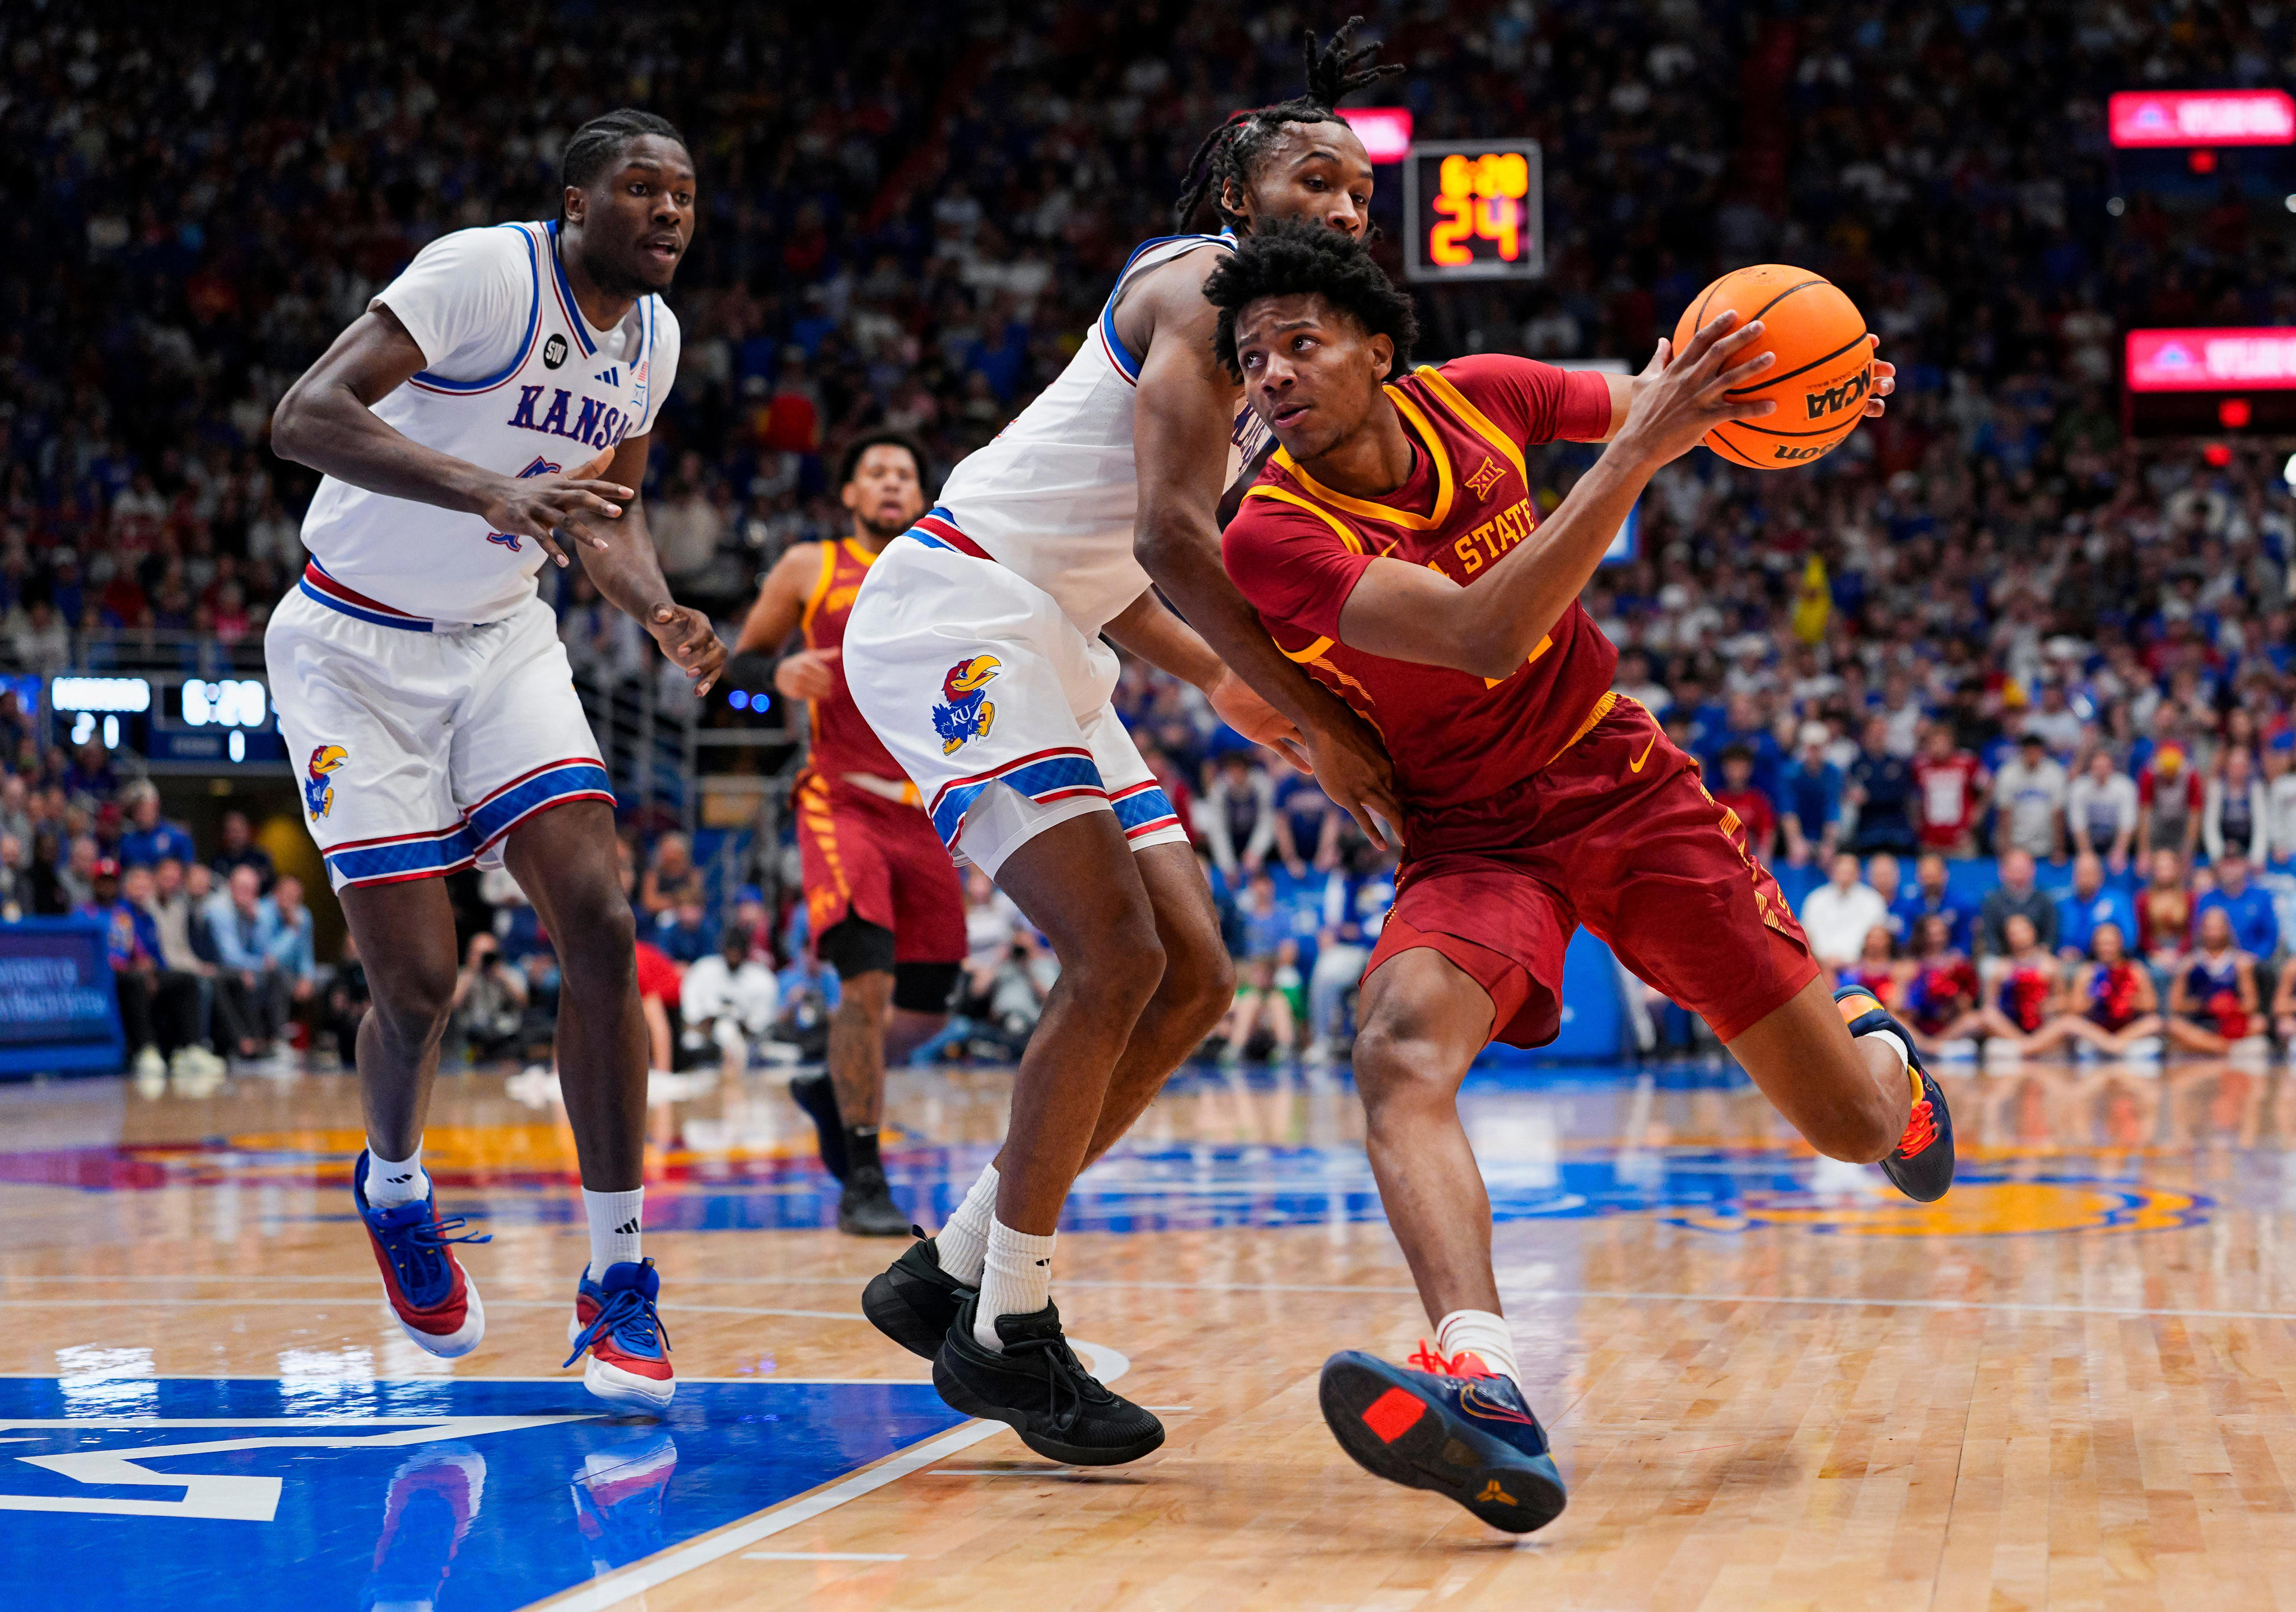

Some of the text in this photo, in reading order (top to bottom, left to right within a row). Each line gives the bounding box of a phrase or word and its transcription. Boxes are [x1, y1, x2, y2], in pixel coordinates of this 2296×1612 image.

[1430, 194, 1519, 267] 24
[545, 340, 567, 364] SW
[1806, 361, 1871, 420] NCAA
[1454, 497, 1535, 575] STATE
[949, 705, 971, 726] KU
